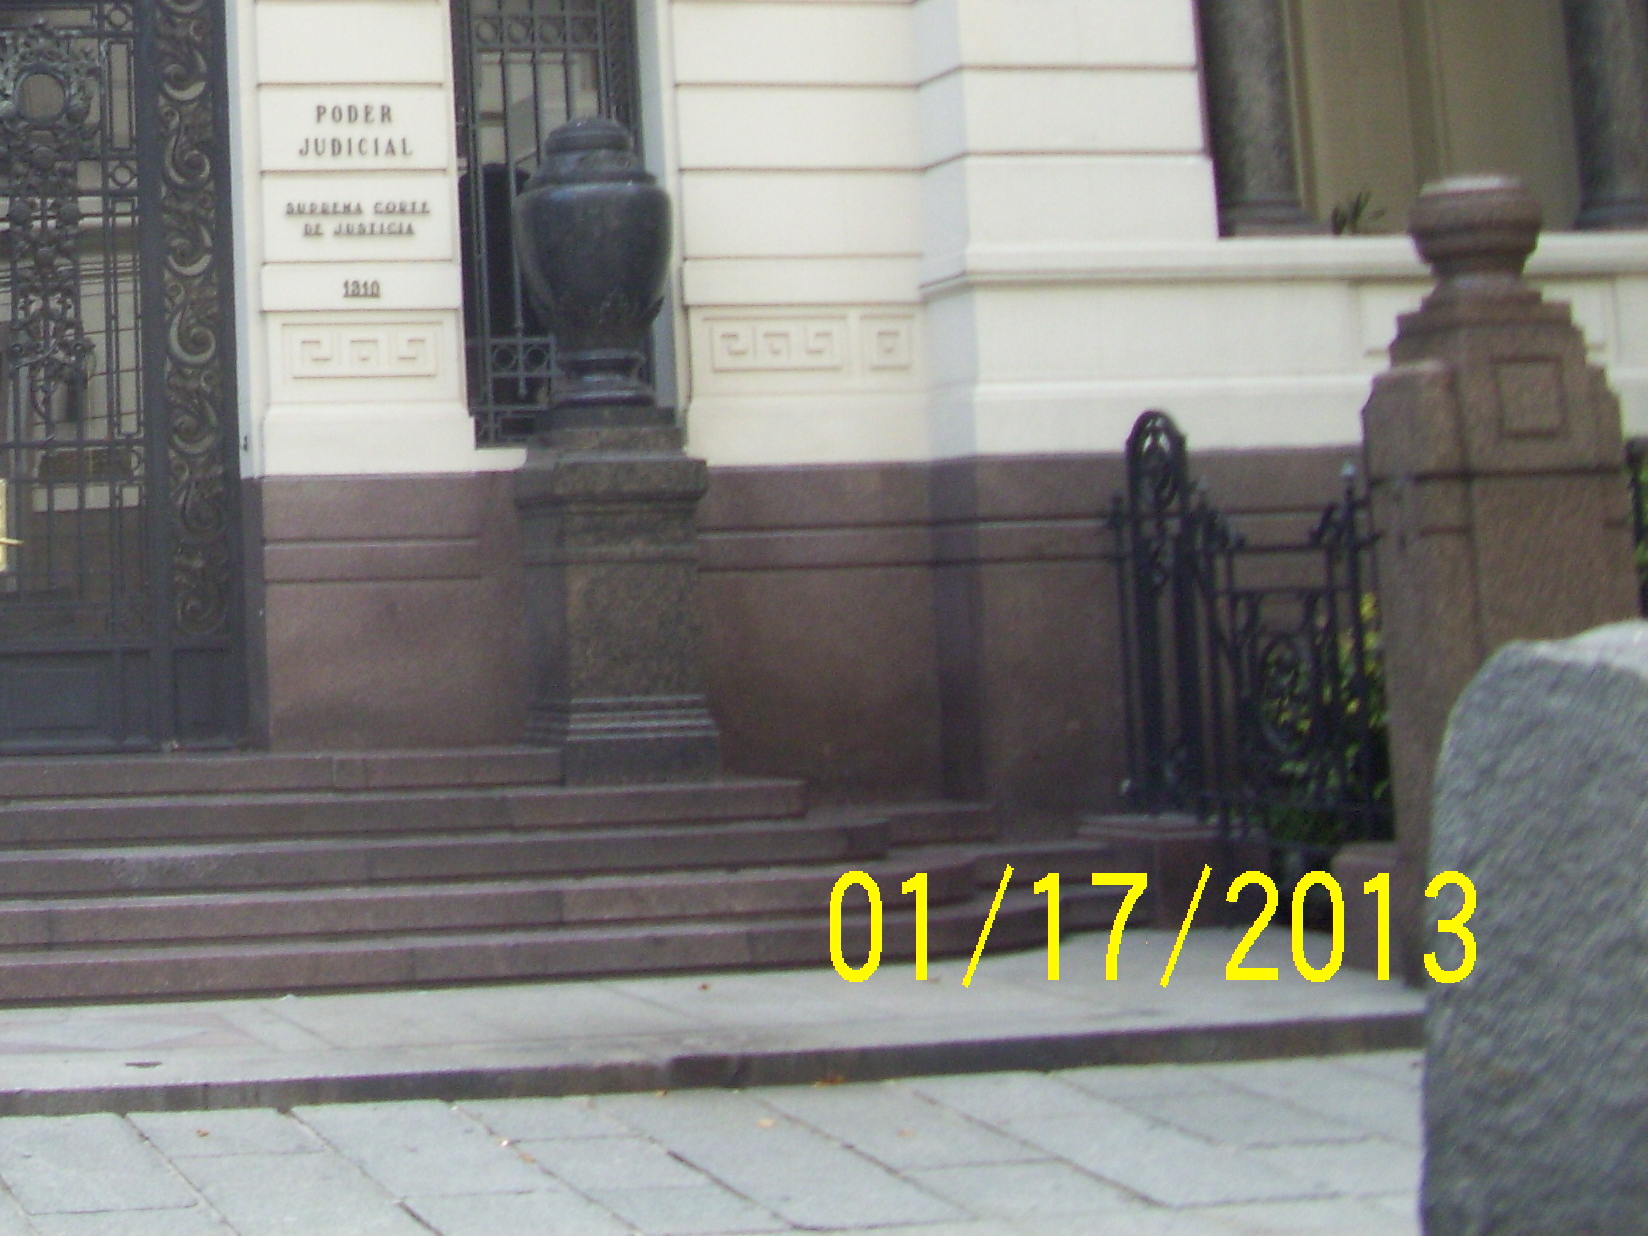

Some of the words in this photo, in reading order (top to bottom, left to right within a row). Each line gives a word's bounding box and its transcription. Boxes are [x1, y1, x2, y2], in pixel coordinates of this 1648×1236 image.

[315, 104, 393, 124] PODER
[298, 137, 413, 157] JUDICIAL
[286, 202, 363, 215] SUPREMA
[373, 202, 430, 215] CORTE
[303, 222, 323, 236] DE
[332, 222, 415, 236] JUSTICIA
